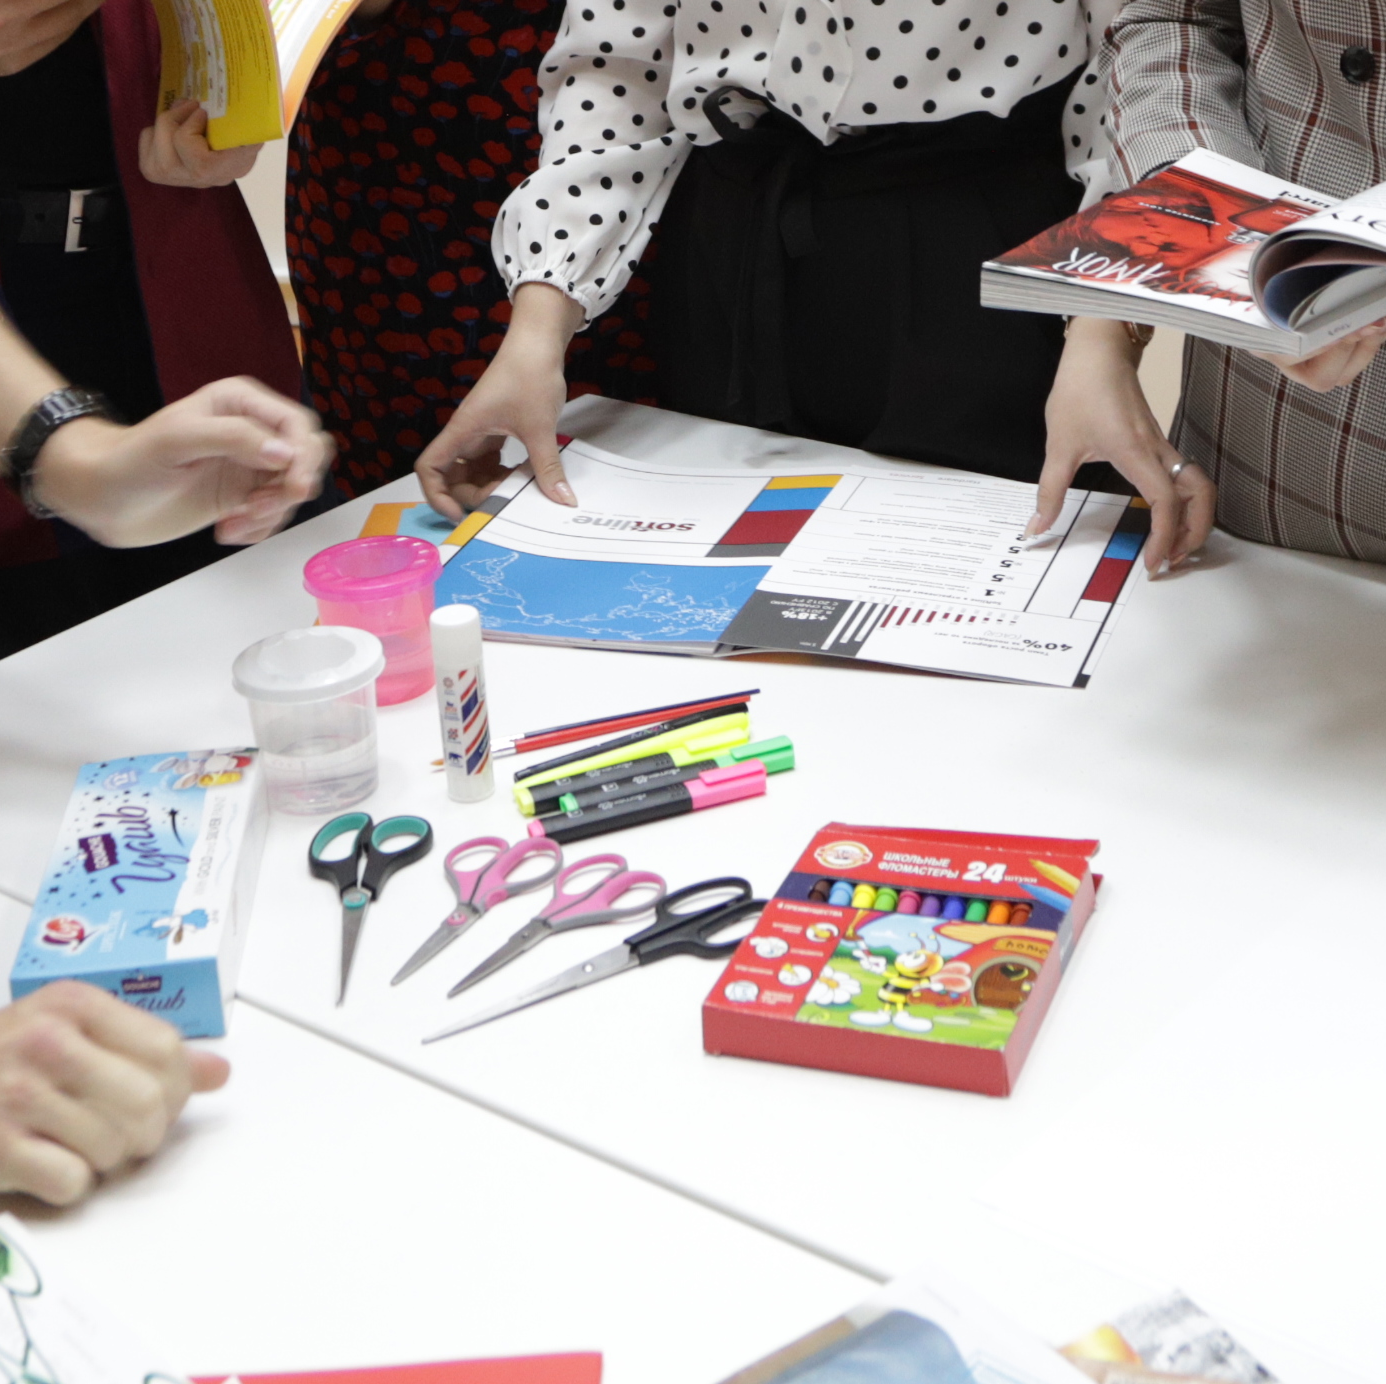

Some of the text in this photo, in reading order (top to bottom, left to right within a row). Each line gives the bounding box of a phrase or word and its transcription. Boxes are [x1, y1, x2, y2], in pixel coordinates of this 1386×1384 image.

[1051, 246, 1171, 285] AMOR
[571, 515, 697, 533] softline
[780, 609, 829, 622] +18%
[1022, 638, 1074, 652] 40%
[94, 805, 192, 896] Гуашь
[882, 851, 952, 868] ШКОЛЬНЫЕ
[196, 855, 214, 880] GOLD
[877, 860, 1039, 885] ФЛОМАСТЕРЫ 24 штуки
